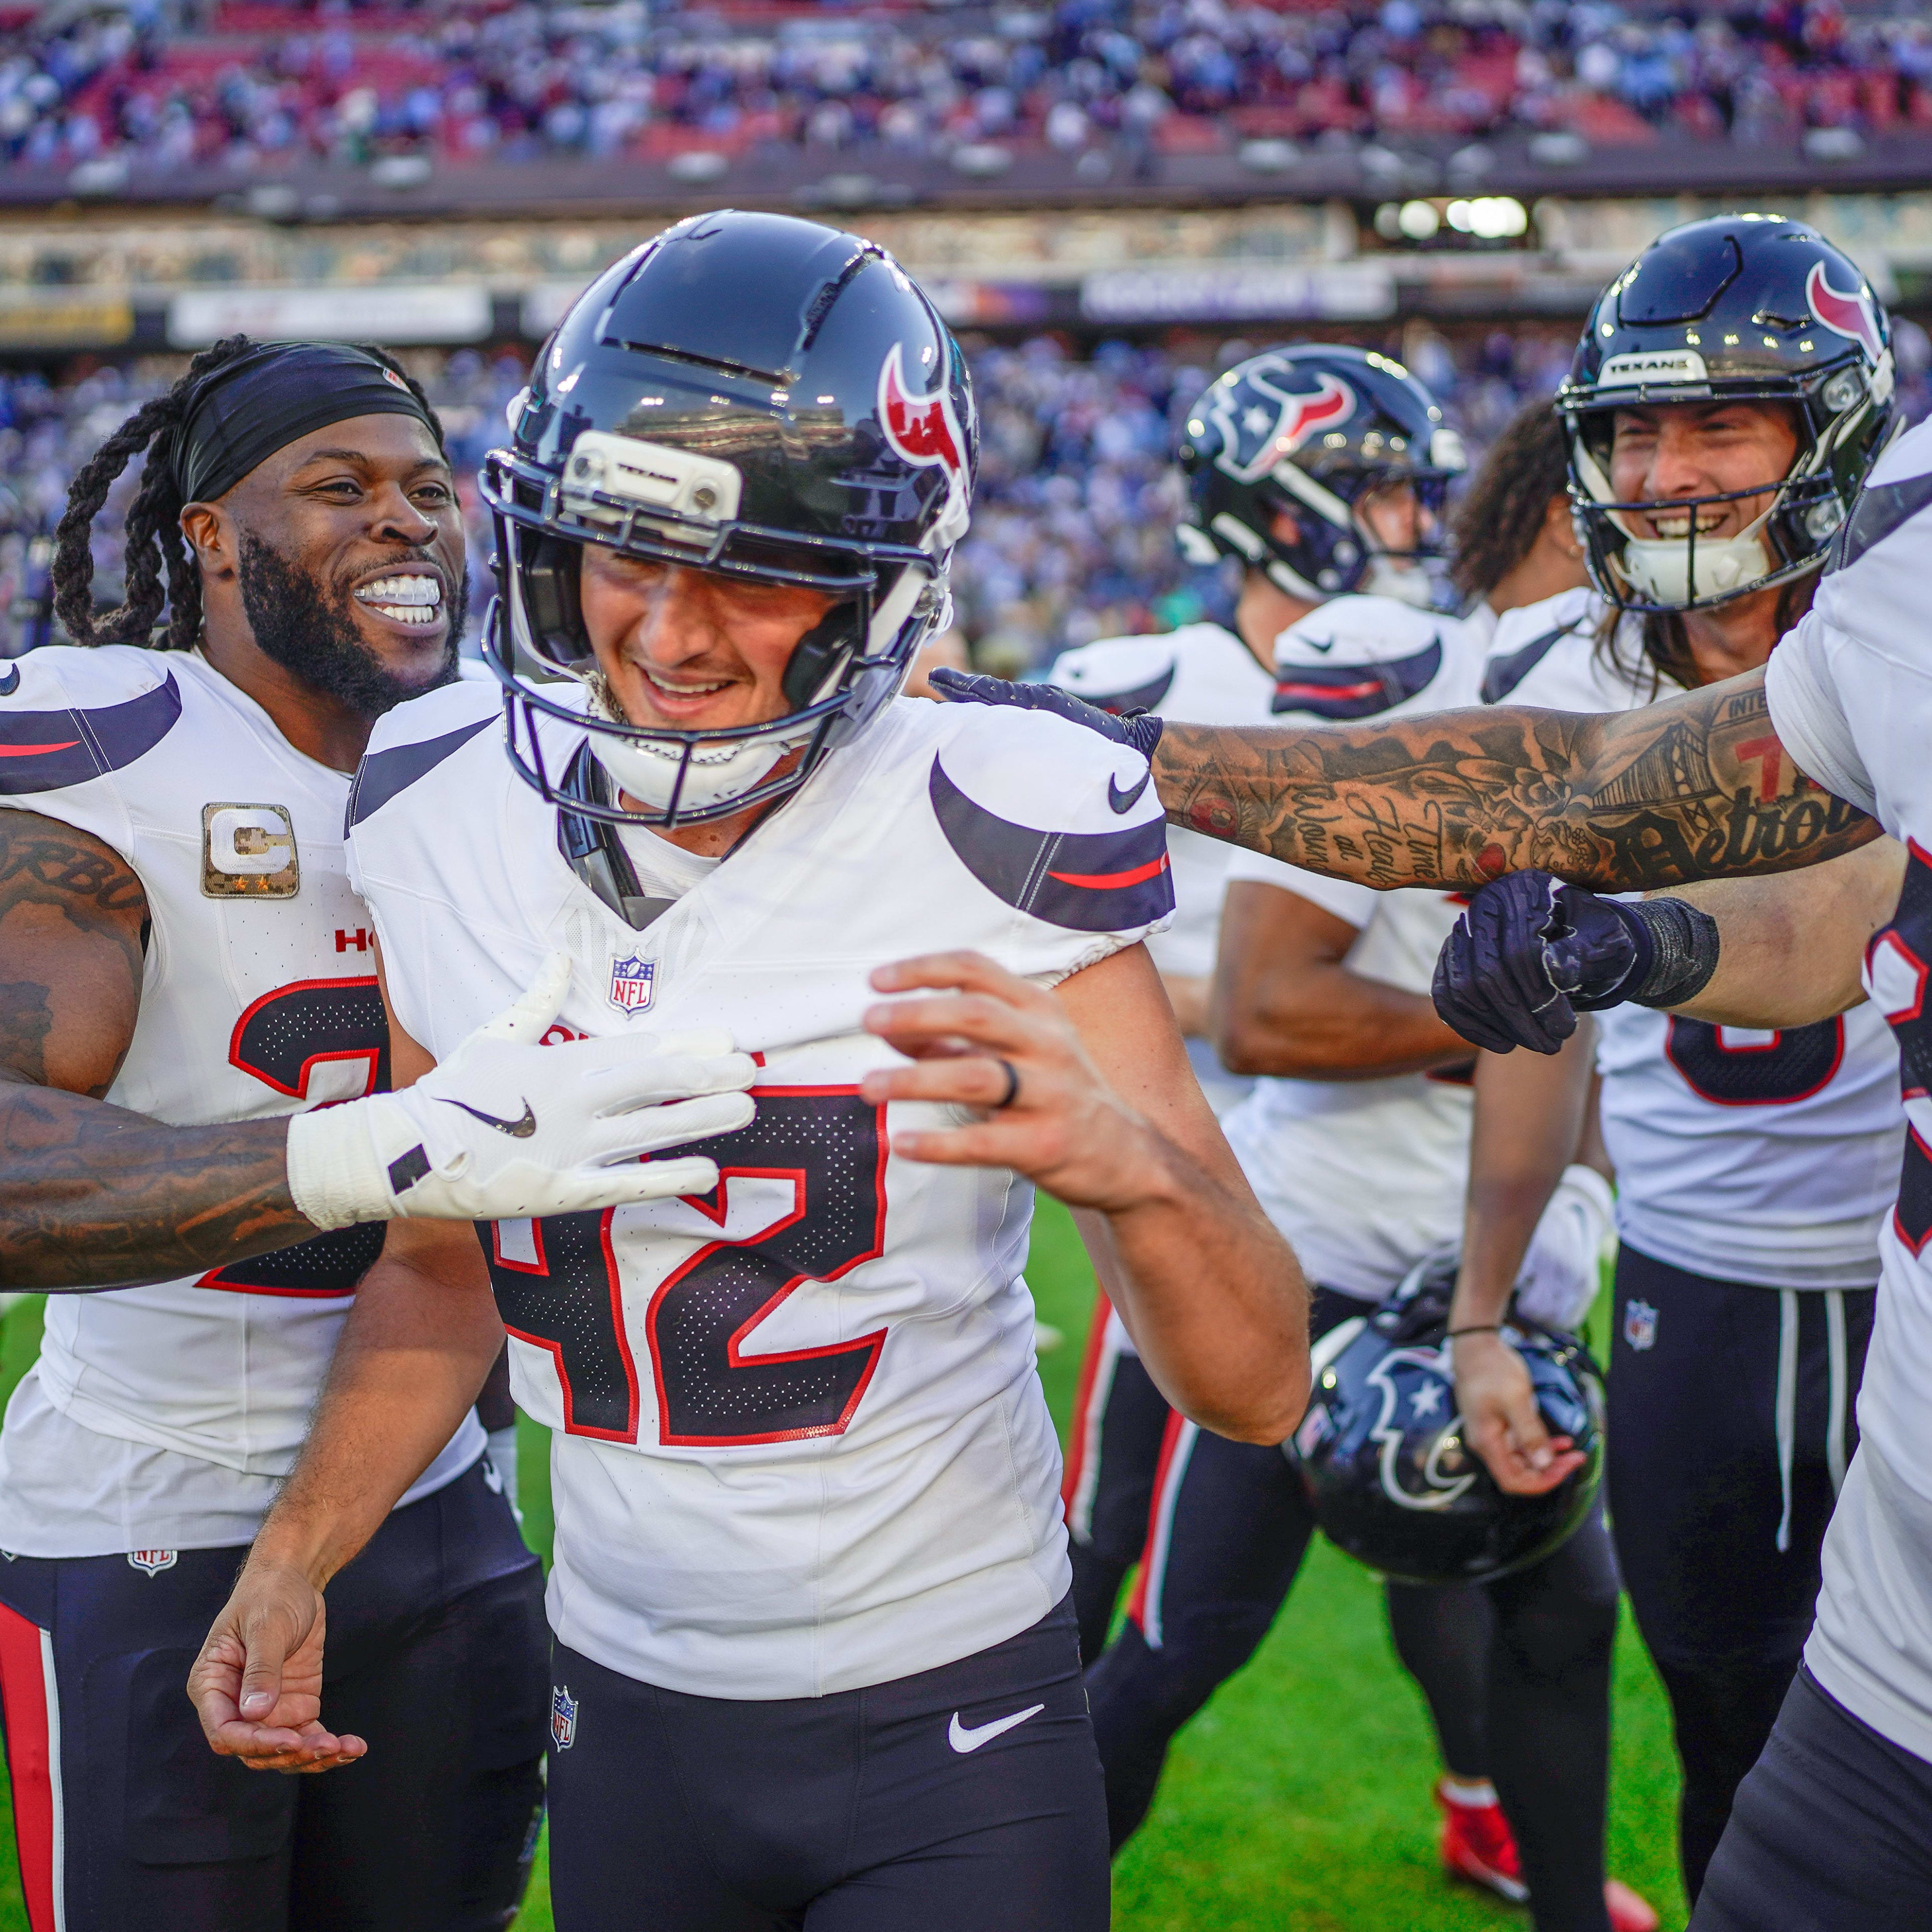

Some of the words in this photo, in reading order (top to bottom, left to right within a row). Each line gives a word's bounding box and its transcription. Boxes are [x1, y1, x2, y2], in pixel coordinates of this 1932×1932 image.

[1611, 357, 1689, 375] TEXANS
[210, 808, 293, 875] C
[1290, 784, 1352, 878] Wound
[1333, 834, 1364, 861] all
[1345, 792, 1411, 887] Heals
[1404, 799, 1445, 880] Time
[335, 928, 374, 952] H
[613, 980, 647, 1006] NFL
[473, 1084, 889, 1446] 42
[554, 1711, 569, 1741] NFL
